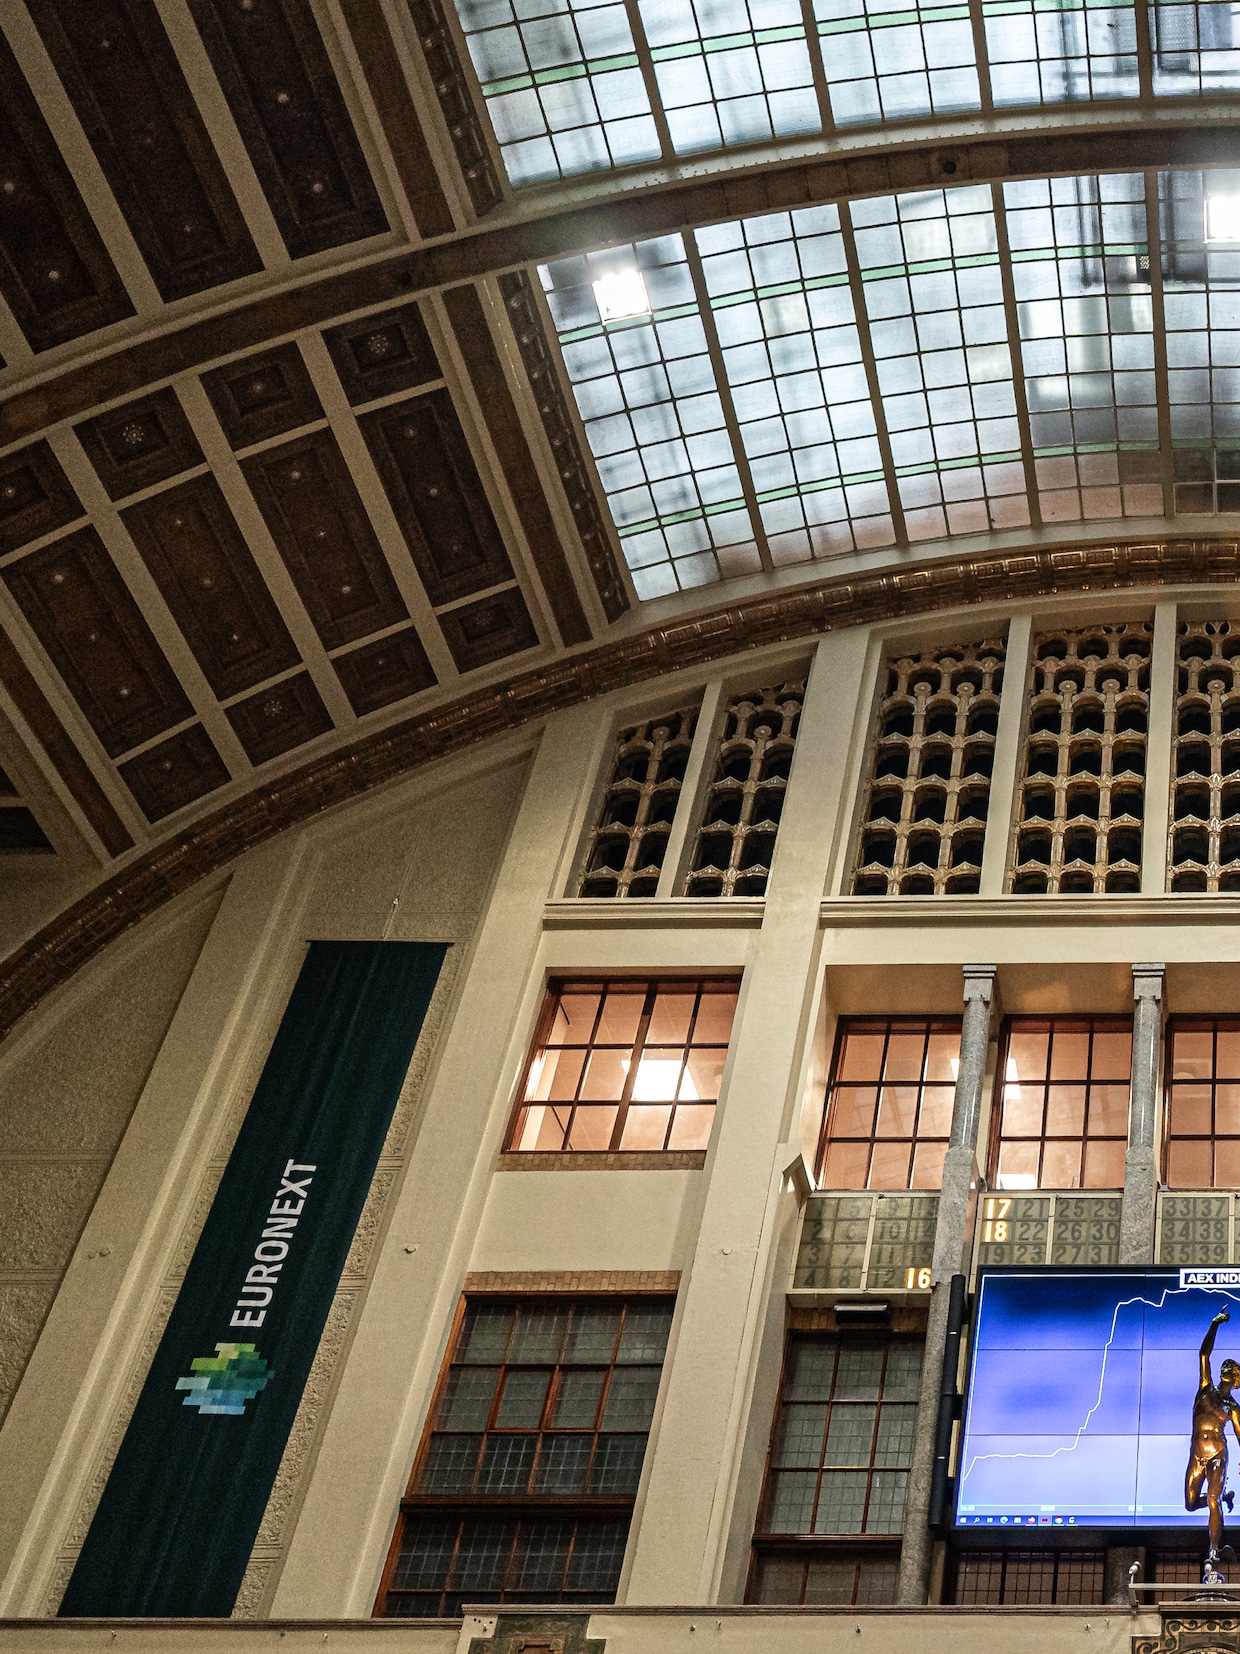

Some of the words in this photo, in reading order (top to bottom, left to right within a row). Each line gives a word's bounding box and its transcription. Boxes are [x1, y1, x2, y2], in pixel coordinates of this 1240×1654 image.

[888, 1199, 900, 1218] 9
[986, 1199, 1012, 1219] 17
[1022, 1200, 1044, 1218] 21
[1058, 1200, 1085, 1218] 25
[1093, 1200, 1119, 1218] 29
[1165, 1200, 1190, 1217] 33
[1201, 1200, 1226, 1217] 37
[811, 1221, 825, 1242] 2
[879, 1221, 901, 1241] 10
[984, 1221, 1008, 1242] 18
[1018, 1222, 1045, 1242] 22
[1056, 1222, 1082, 1242] 26
[1091, 1222, 1119, 1242] 30
[1164, 1221, 1190, 1241] 34
[1200, 1221, 1225, 1241] 38
[229, 1158, 317, 1328] EURONEXT
[808, 1246, 821, 1265] 3
[844, 1246, 856, 1264] 7
[876, 1246, 895, 1265] 11
[984, 1245, 1006, 1264] 19
[1016, 1245, 1043, 1264] 23
[1054, 1245, 1081, 1264] 27
[1090, 1245, 1114, 1264] 31
[1163, 1245, 1190, 1264] 35
[1199, 1245, 1225, 1264] 39
[804, 1269, 817, 1287] 4
[838, 1270, 851, 1288] 8
[873, 1269, 896, 1288] 12
[906, 1267, 932, 1289] 16
[1187, 1274, 1213, 1284] AEX
